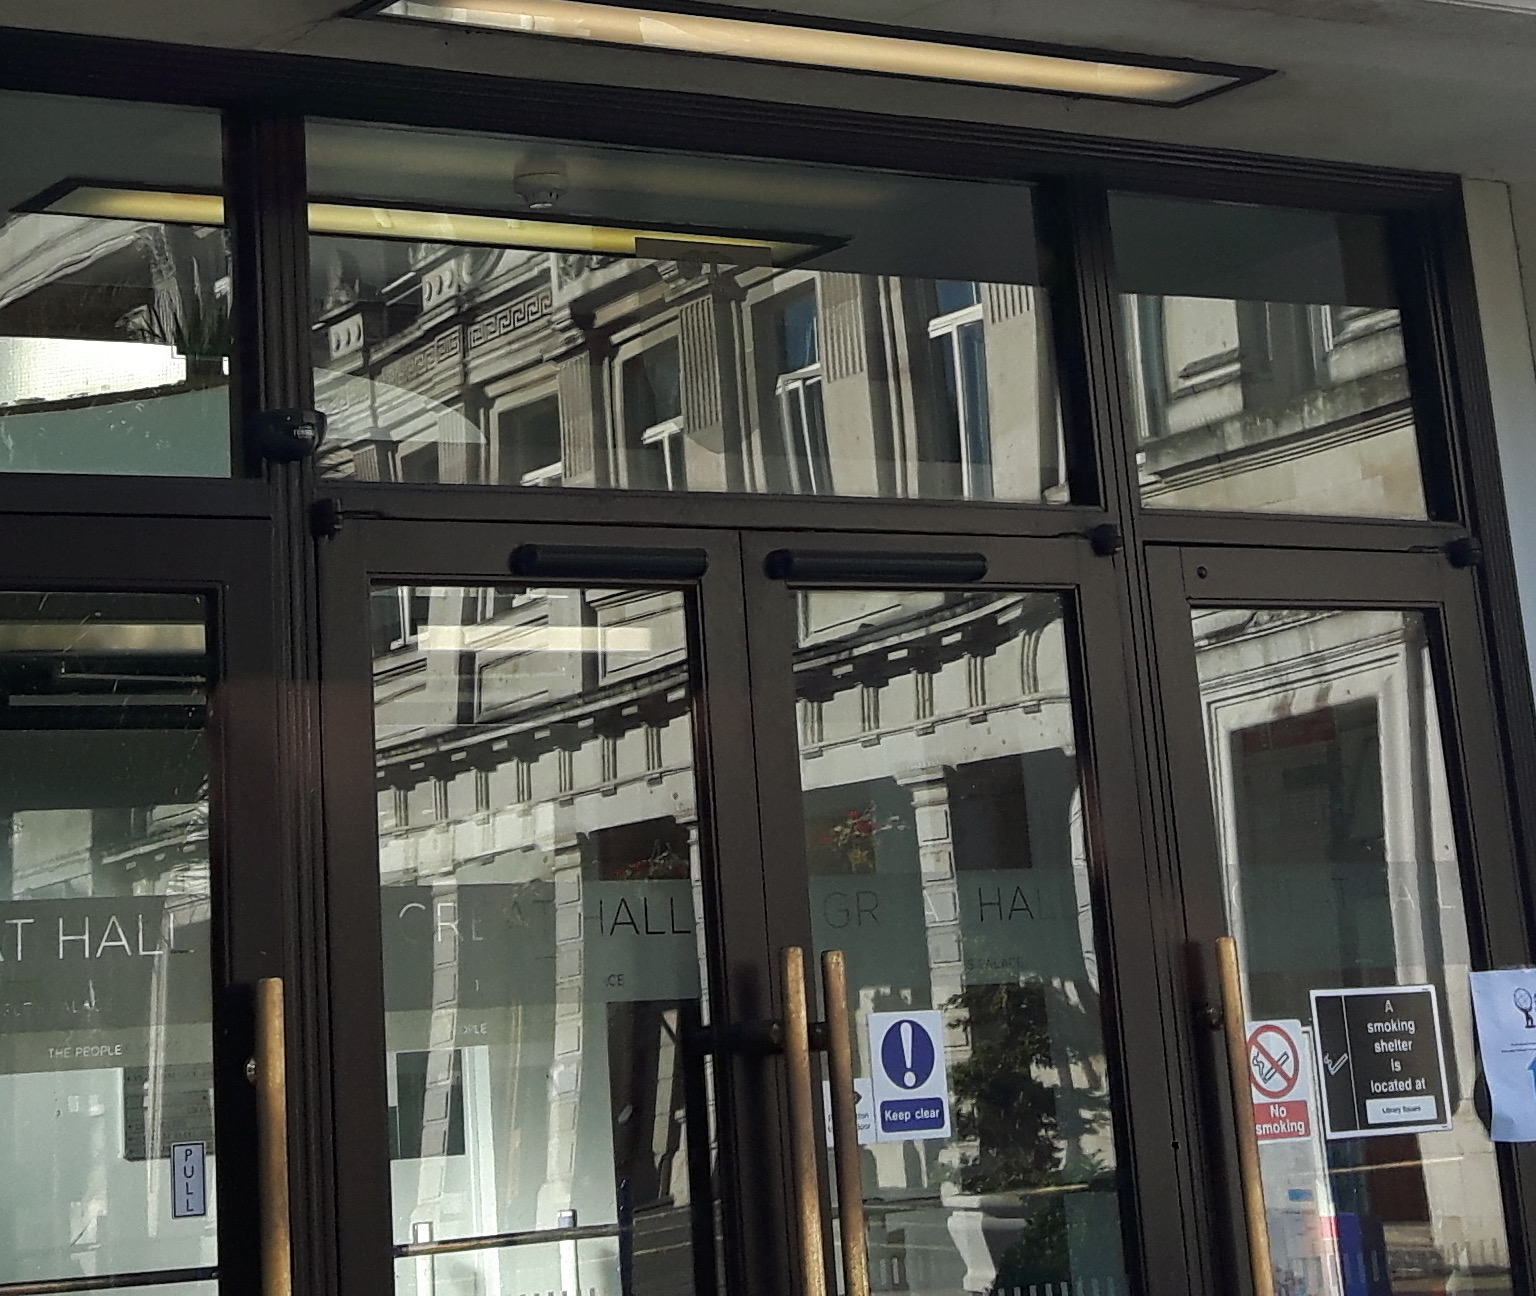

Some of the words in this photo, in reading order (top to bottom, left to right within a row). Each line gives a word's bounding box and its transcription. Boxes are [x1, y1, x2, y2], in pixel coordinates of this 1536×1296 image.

[58, 913, 195, 961] HALL
[1385, 999, 1394, 1013] A
[1366, 1018, 1415, 1034] smoking
[75, 1044, 123, 1058] PEOPLE
[1374, 1039, 1413, 1053] shelter
[1390, 1058, 1402, 1072] is
[1370, 1077, 1412, 1093] located
[1415, 1077, 1426, 1090] at
[884, 1109, 911, 1122] Keep
[915, 1108, 940, 1120] clear
[1270, 1104, 1287, 1118] No
[1255, 1119, 1306, 1136] smoking
[183, 1148, 195, 1212] PULL
